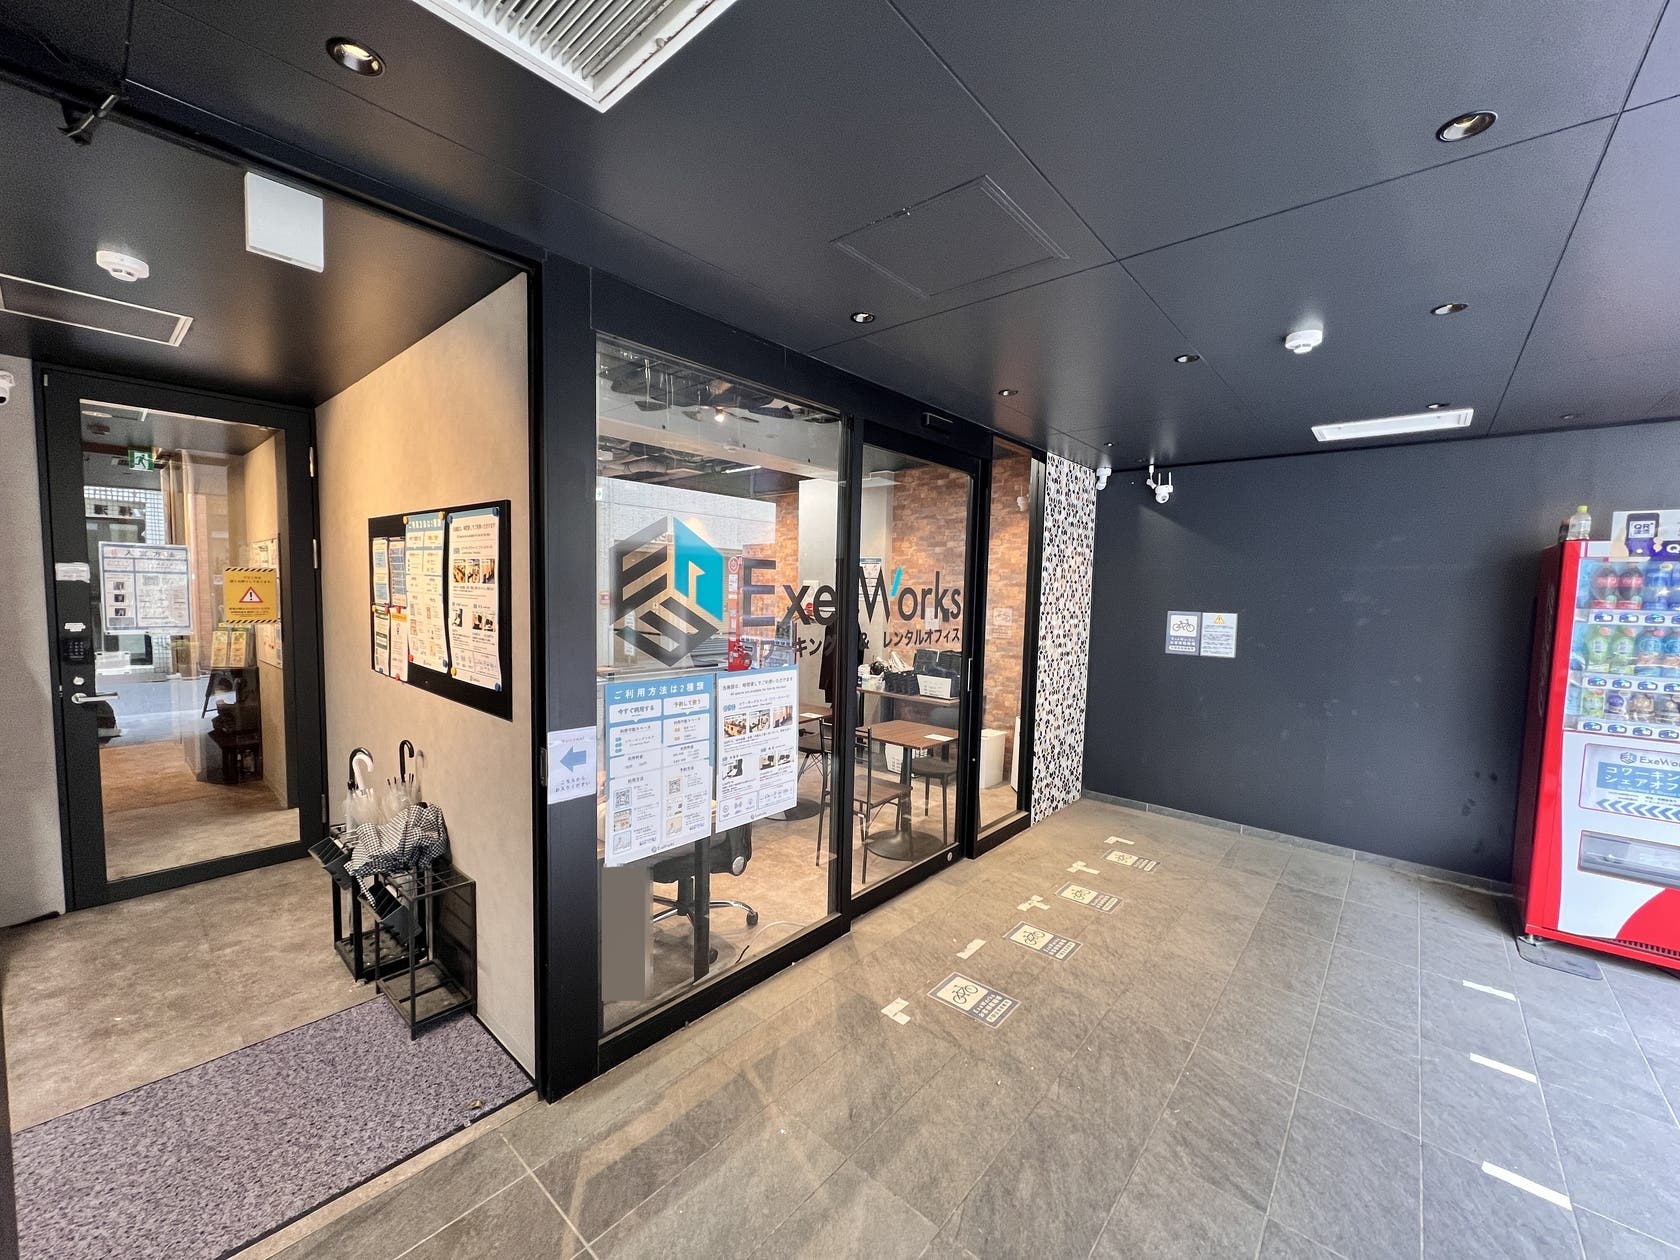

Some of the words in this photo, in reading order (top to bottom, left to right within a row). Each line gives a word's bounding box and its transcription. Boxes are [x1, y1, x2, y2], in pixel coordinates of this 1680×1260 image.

[883, 627, 960, 648] レンタルオフィス
[1604, 774, 1679, 791] シェアオフ
